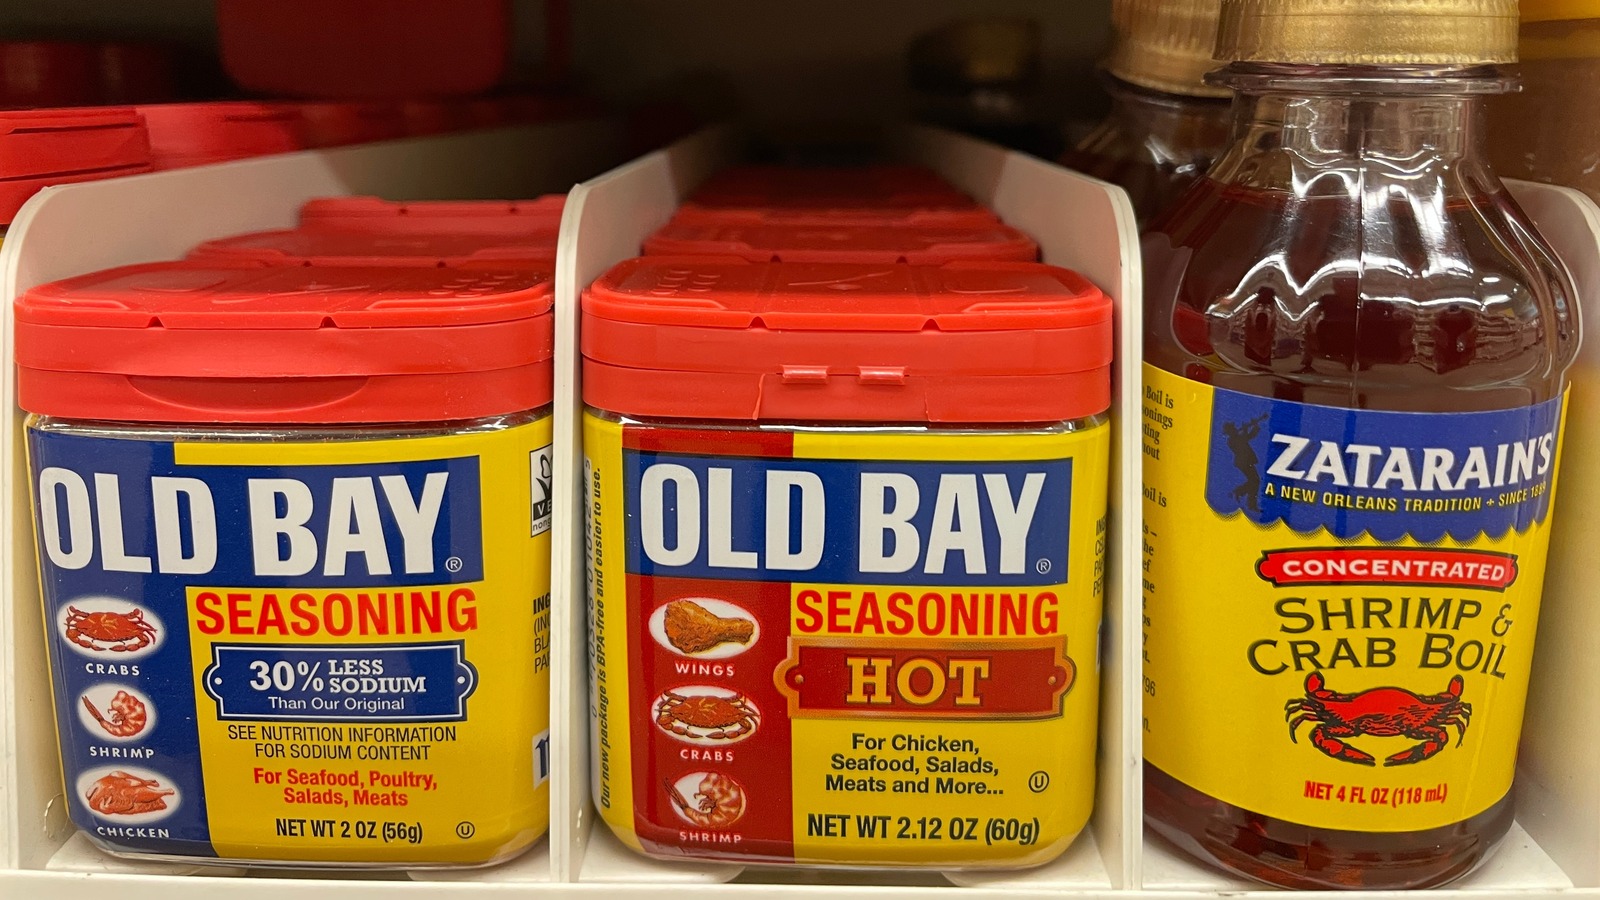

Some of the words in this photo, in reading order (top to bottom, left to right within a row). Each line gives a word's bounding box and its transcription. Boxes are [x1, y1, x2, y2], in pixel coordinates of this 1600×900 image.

[1146, 385, 1164, 404] Boil
[1165, 395, 1174, 409] is
[1266, 432, 1552, 491] ZATARAIN'S
[593, 468, 601, 498] use.
[594, 502, 601, 516] to
[1158, 491, 1167, 508] is
[1265, 483, 1275, 496] A
[1281, 485, 1316, 503] NEW
[1322, 492, 1397, 511] ORLEANS
[1404, 497, 1482, 512] TRADITION
[1498, 489, 1528, 507] SINCE
[39, 466, 218, 575] OLD
[248, 471, 449, 577] BAY
[640, 463, 826, 571] OLD
[859, 472, 1046, 575] BAY
[594, 518, 603, 567] easier
[1282, 559, 1505, 581] CONCENTRATED
[594, 569, 604, 597] and
[195, 587, 478, 637] SEASONING
[795, 590, 1059, 636] SEASONING
[1274, 597, 1482, 633] SHRIMP
[1491, 603, 1513, 637] &
[596, 601, 606, 667] BPA-free
[328, 659, 384, 676] LESS
[1247, 637, 1396, 676] CRAB
[85, 663, 140, 676] CRABS
[249, 660, 324, 692] 30%
[598, 669, 607, 682] is
[675, 663, 735, 676] WINGS
[845, 656, 990, 705] HOT
[329, 676, 427, 694] SODIUM
[268, 696, 306, 710] Than
[311, 697, 339, 711] Our
[344, 697, 405, 713] Original
[599, 686, 611, 749] package
[228, 725, 257, 740] SEE
[261, 725, 343, 742] NUTRITION
[349, 726, 456, 742] INFORMATION
[851, 732, 886, 751] For
[891, 734, 979, 755] Chicken,
[90, 746, 154, 759] SHRIMP
[255, 743, 285, 758] FOR
[290, 744, 352, 760] SODIUM
[358, 745, 431, 760] CONTENT
[680, 749, 734, 762] CRABS
[601, 751, 610, 781] new
[830, 753, 920, 775] Seafood,
[926, 755, 999, 776] Salads,
[253, 767, 282, 784] For
[287, 768, 365, 790] Seafood,
[369, 770, 438, 790] Poultry,
[825, 774, 886, 793] Meats
[892, 777, 929, 794] and
[936, 777, 1004, 795] More...
[283, 787, 349, 808] Salads,
[353, 790, 408, 807] Meats
[601, 782, 611, 809] Our
[1303, 780, 1334, 800] NET
[1336, 785, 1346, 802] 4
[1350, 786, 1366, 804] FL
[1370, 788, 1389, 804] OZ
[1392, 787, 1422, 808] (118
[1424, 783, 1448, 804] mL)
[97, 826, 169, 839] CHICKEN
[276, 818, 306, 837] NET
[310, 819, 336, 838] WT
[341, 820, 351, 838] 2
[355, 821, 377, 839] OZ
[382, 822, 423, 844] (56g)
[679, 831, 742, 844] SHRIMP
[807, 813, 850, 838] NET
[856, 815, 891, 839] WT
[896, 816, 942, 840] 2.12
[949, 817, 979, 841] OZ
[985, 817, 1040, 846] (60g)
